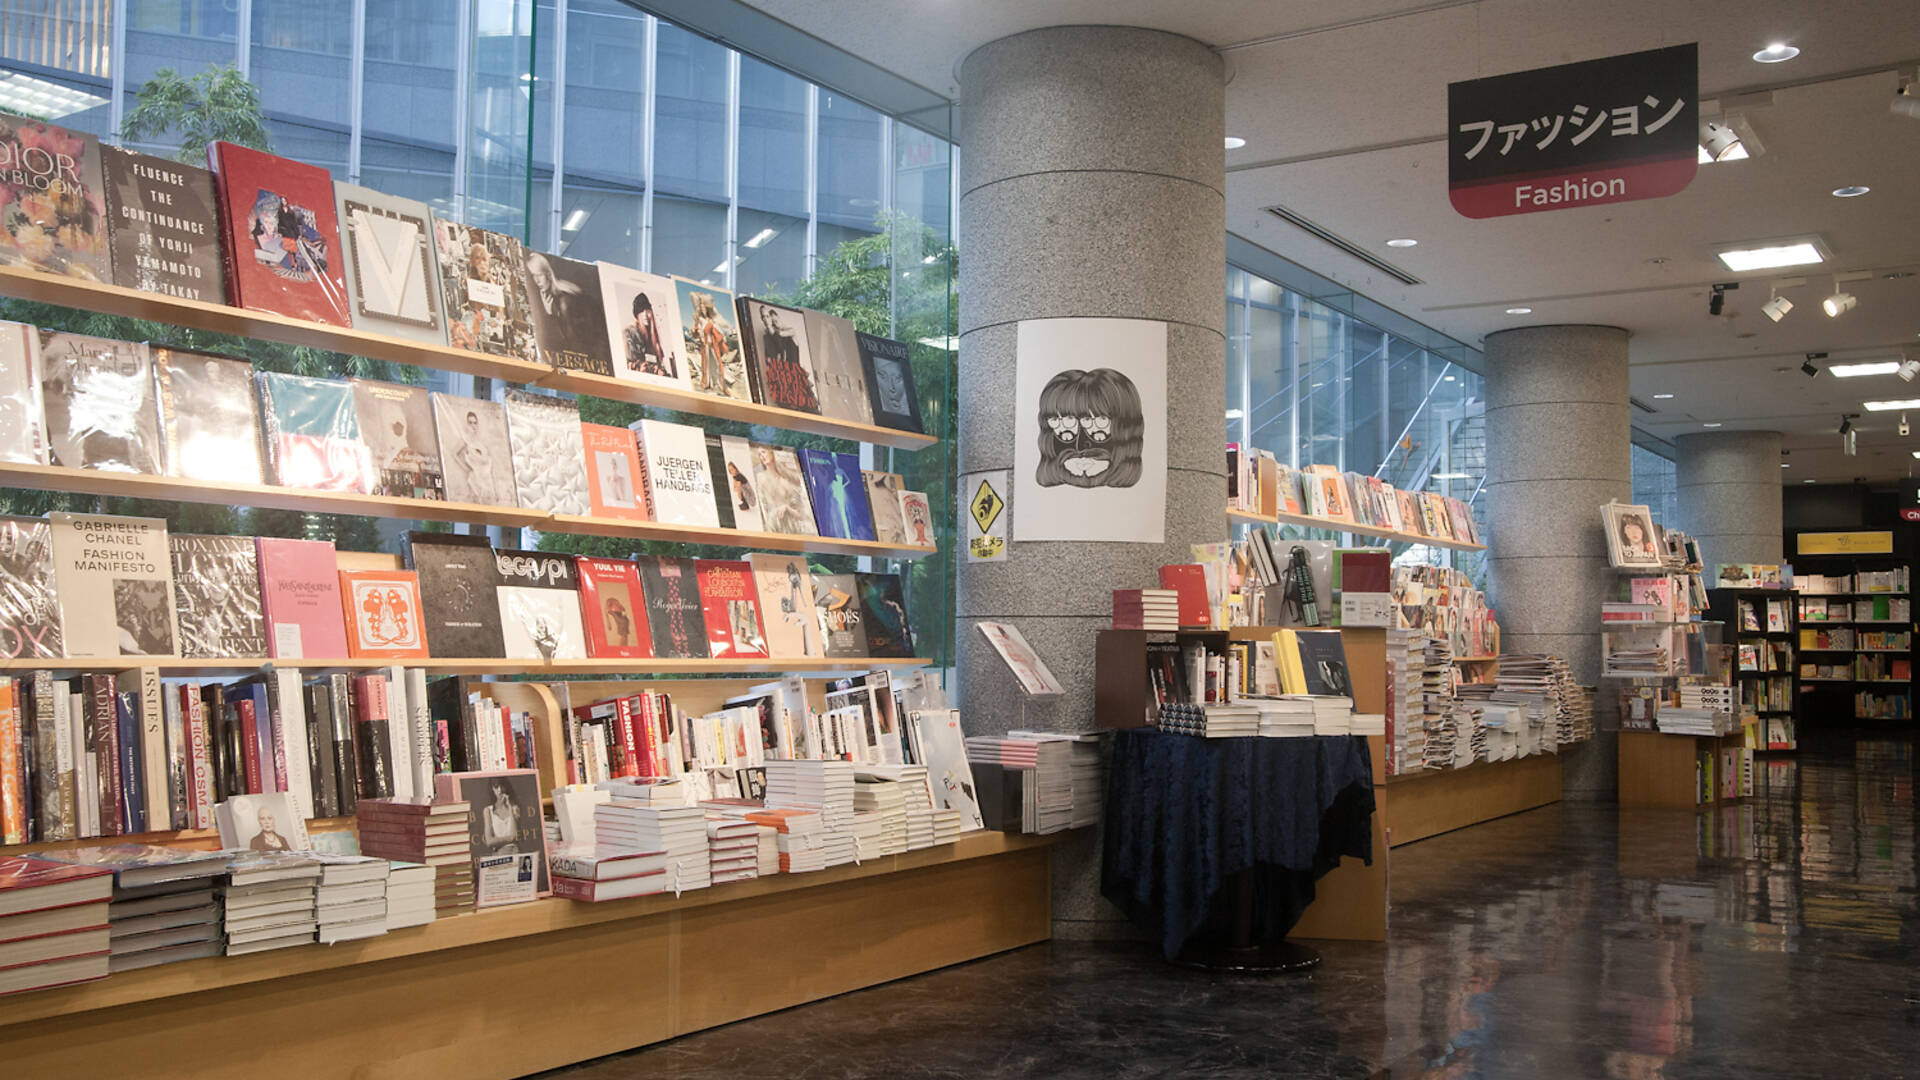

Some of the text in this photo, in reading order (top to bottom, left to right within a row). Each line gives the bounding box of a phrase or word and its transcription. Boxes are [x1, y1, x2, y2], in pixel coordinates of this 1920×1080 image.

[1460, 95, 1686, 161] ファッション
[13, 169, 84, 198] BLOOM
[133, 163, 184, 187] FLUENCE
[150, 190, 173, 206] THE
[1515, 177, 1626, 208] Fashion
[122, 205, 205, 236] CONTINUANCE
[139, 233, 193, 254] OF YOHJI
[136, 254, 201, 279] YAMAMOTO
[162, 282, 200, 301] TAKAY
[656, 456, 704, 471] JUERGEN
[655, 478, 711, 495] HANDBAS
[73, 520, 149, 535] GABRIELLE
[85, 533, 143, 546] CHANEL
[83, 549, 145, 561] FASHION
[75, 561, 156, 573] MANIFESTO
[823, 608, 860, 624] SHOES
[145, 671, 159, 734] ISSUES
[94, 687, 111, 742] ADRIAN
[621, 700, 635, 752] FASHION
[190, 687, 210, 807] FASHION CSM
[471, 829, 538, 847] COEPT
[550, 855, 577, 871] RADA
